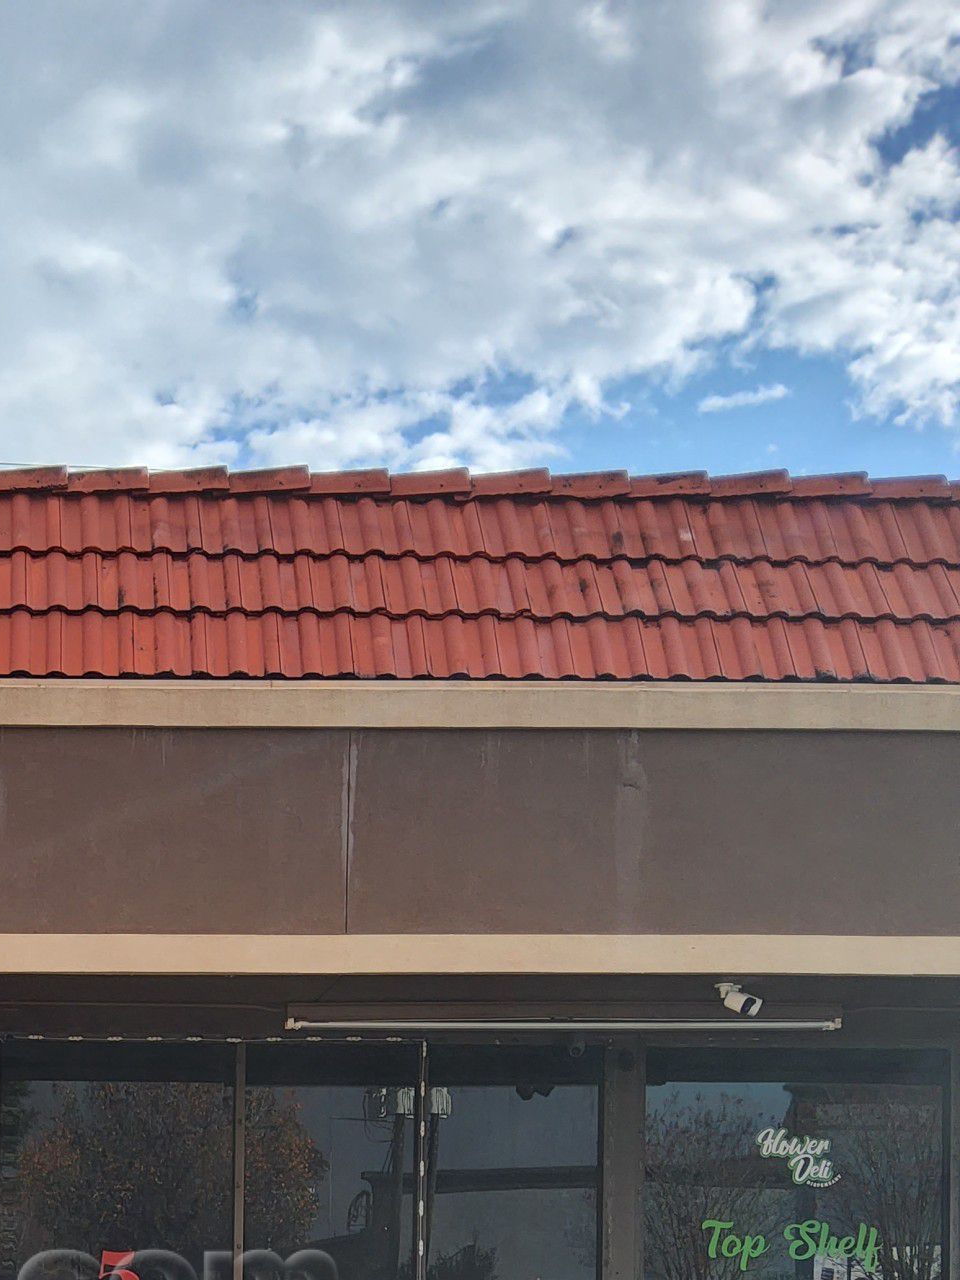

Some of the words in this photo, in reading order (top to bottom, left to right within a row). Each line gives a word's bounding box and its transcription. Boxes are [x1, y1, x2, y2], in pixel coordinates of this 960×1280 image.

[756, 1127, 830, 1156] Flower
[788, 1154, 833, 1184] Deli
[701, 1219, 771, 1271] Top
[783, 1219, 884, 1273] Shelf
